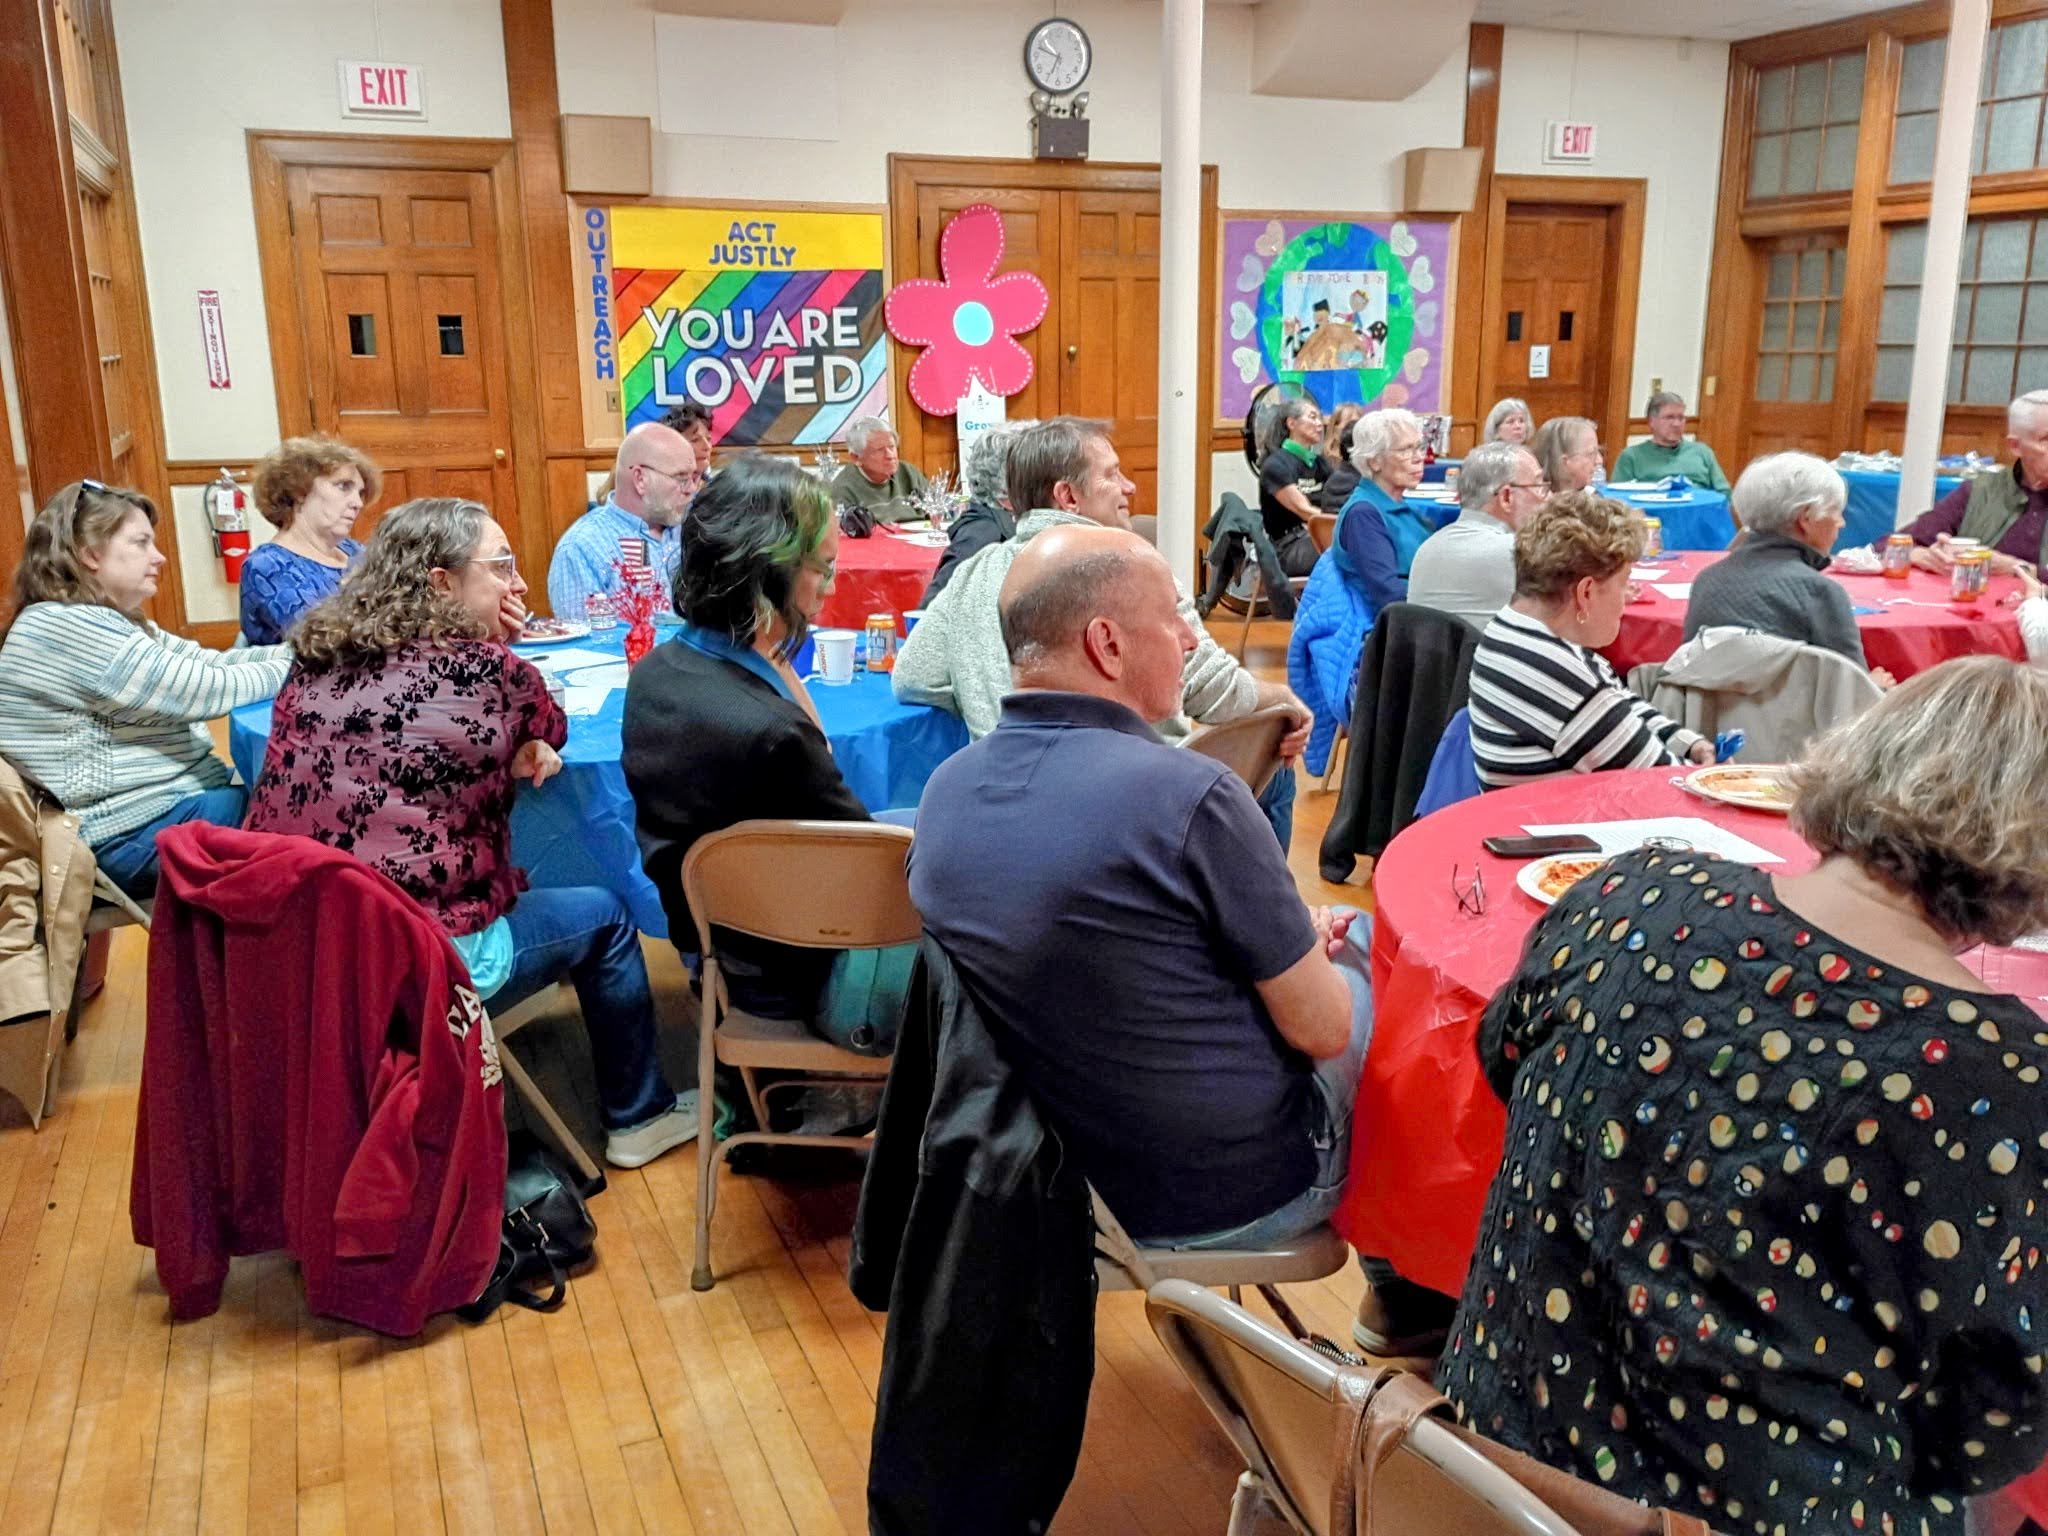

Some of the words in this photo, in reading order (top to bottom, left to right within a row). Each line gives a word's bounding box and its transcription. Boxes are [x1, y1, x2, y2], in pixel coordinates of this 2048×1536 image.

[360, 67, 407, 105] EXIT
[1563, 126, 1592, 153] EXIT
[727, 222, 777, 243] ACT
[709, 244, 797, 267] JUSTLY
[200, 297, 218, 307] FIRE
[584, 208, 614, 380] OUTREACH
[641, 306, 755, 351] YOU
[762, 305, 861, 350] ARE
[652, 355, 864, 407] LOVED
